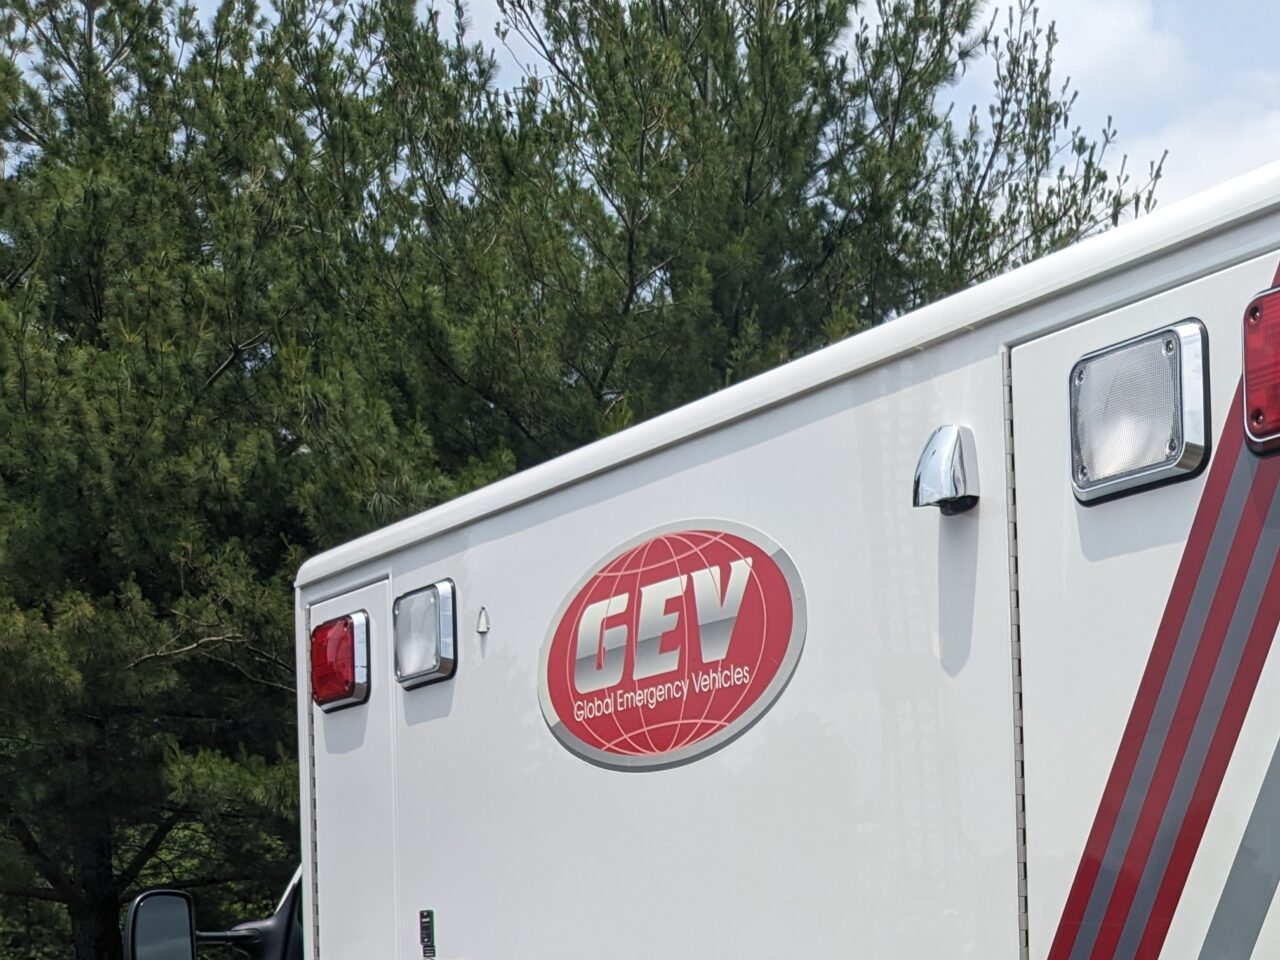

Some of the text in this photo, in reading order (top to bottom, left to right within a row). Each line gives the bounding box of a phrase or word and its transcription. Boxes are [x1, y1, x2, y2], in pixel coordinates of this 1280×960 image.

[574, 556, 753, 695] GEV
[574, 664, 750, 722] Global Emergency Vehicles
